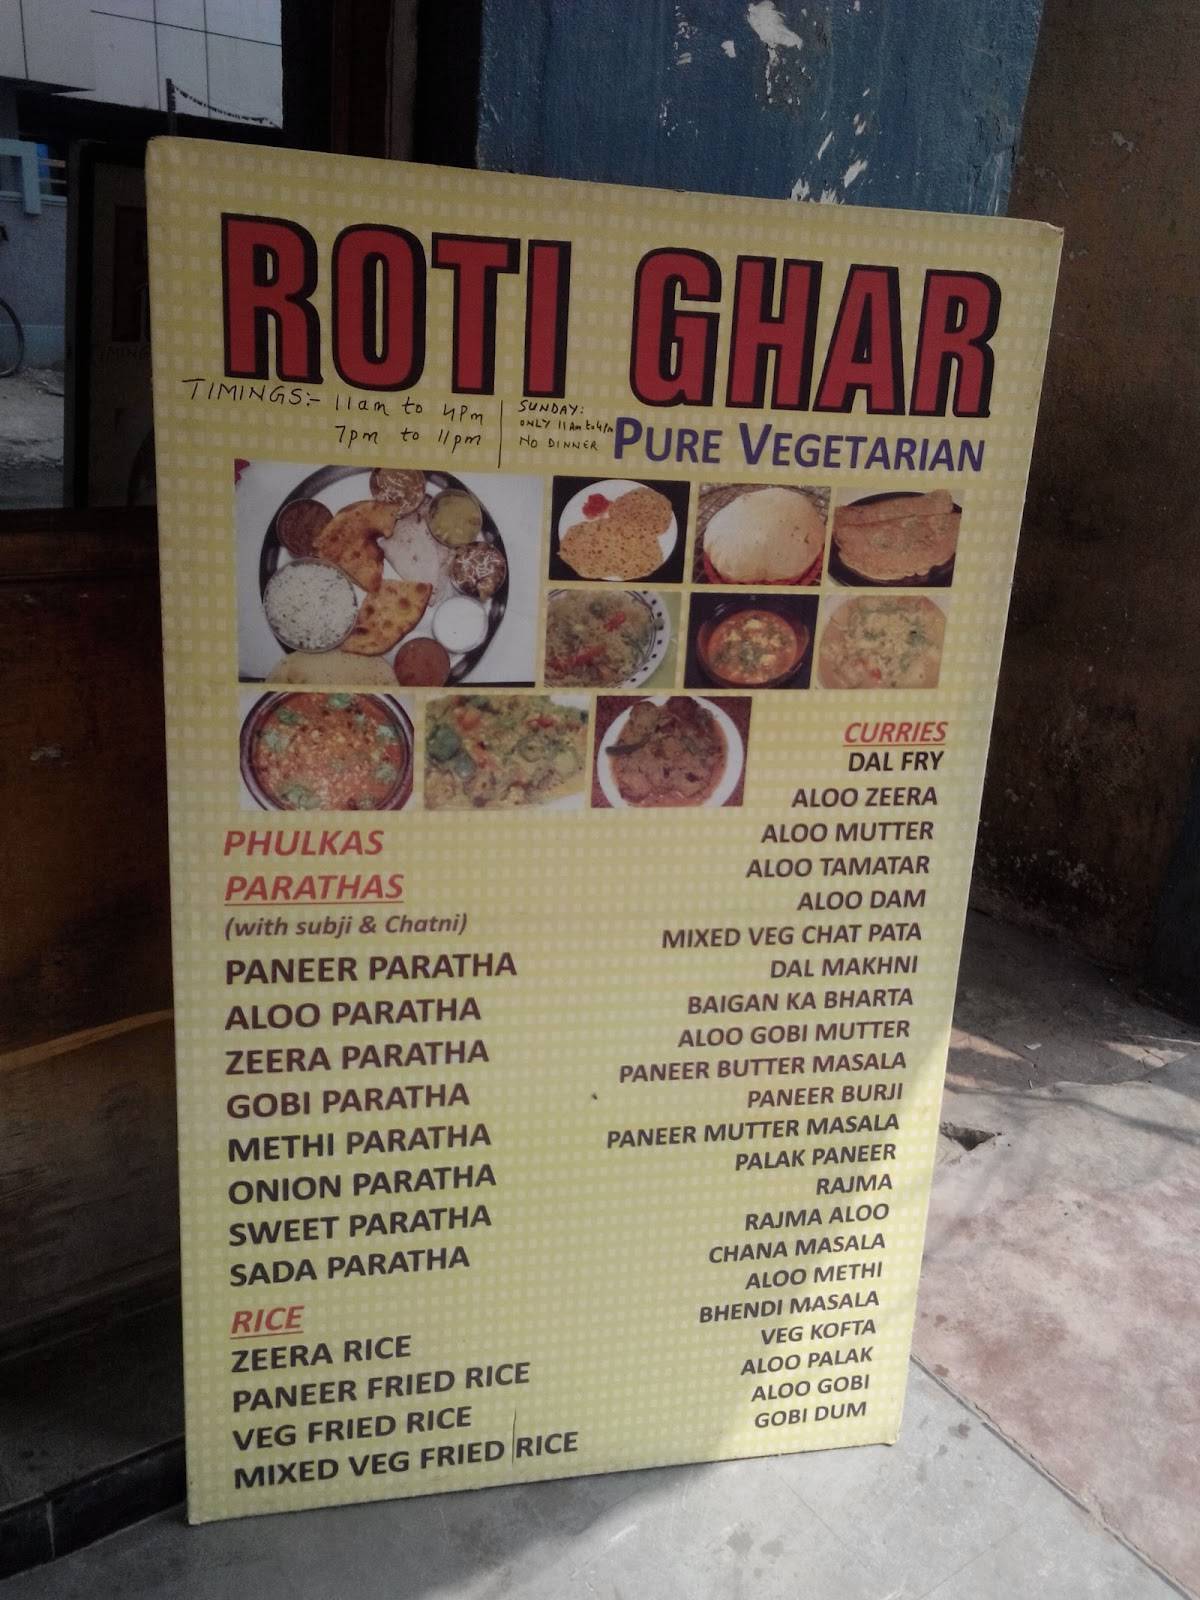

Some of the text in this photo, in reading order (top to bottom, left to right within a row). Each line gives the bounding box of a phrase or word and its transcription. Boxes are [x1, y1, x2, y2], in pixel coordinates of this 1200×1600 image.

[221, 212, 1002, 418] ROTI GHAR
[401, 396, 423, 414] to
[400, 423, 420, 443] to
[520, 420, 551, 428] ONLY
[519, 435, 598, 451] NO DINNER
[843, 721, 949, 744] CURRIES
[848, 750, 944, 772] DAL FRY
[791, 787, 938, 808] ALOO ZEERA
[223, 830, 384, 856] PHULKAS
[761, 821, 934, 843] ALOO MUTTER
[745, 855, 930, 878] ALOO TAMATAR
[224, 874, 404, 901] PARATHAS
[796, 889, 926, 911] ALOO DAM
[224, 913, 468, 940] (with subji & Chatni)
[661, 923, 922, 949] MIXED VEG CHAT PATA
[226, 952, 518, 984] PANEER PARATHA
[769, 955, 918, 979] DAL MAKHNI
[224, 997, 482, 1030] ALOO PARATHA
[687, 988, 913, 1014] BAIGAN KA BHARTA
[678, 1020, 910, 1048] ALOO GOBI MUTTER
[225, 1039, 489, 1075] ZEERA PARATHA
[619, 1052, 907, 1083] PANEER BUTTER MASALA
[226, 1083, 470, 1119] GOBI PARATHA
[747, 1083, 903, 1108] PANEER BURJI
[228, 1123, 492, 1162] METHI PARATHA
[607, 1114, 900, 1148] PANEER MUTTER MASALA
[735, 1144, 896, 1171] PALAK PANEER
[228, 1164, 497, 1205] ONION PARATHA
[816, 1174, 893, 1195] RAJMA
[229, 1204, 492, 1246] SWEET PARATHA
[745, 1203, 889, 1231] RAJMA ALOO
[708, 1233, 886, 1263] CHANA MASALA
[230, 1246, 470, 1287] SADA PARATHA
[745, 1262, 882, 1290] ALOO METHI
[231, 1306, 304, 1334] RICE
[699, 1291, 879, 1323] BHENDI MASALA
[761, 1319, 876, 1345] VEG KOFTA
[231, 1335, 411, 1373] ZEERA RICE
[740, 1346, 874, 1376] ALOO PALAK
[233, 1362, 531, 1412] PANEER FRIED RICE
[751, 1374, 869, 1401] ALOO GOBI
[232, 1406, 472, 1451] VEG FRIED RICE
[754, 1402, 866, 1428] GOBI DUM
[234, 1432, 579, 1489] MIXED VEG FRIED RICE
